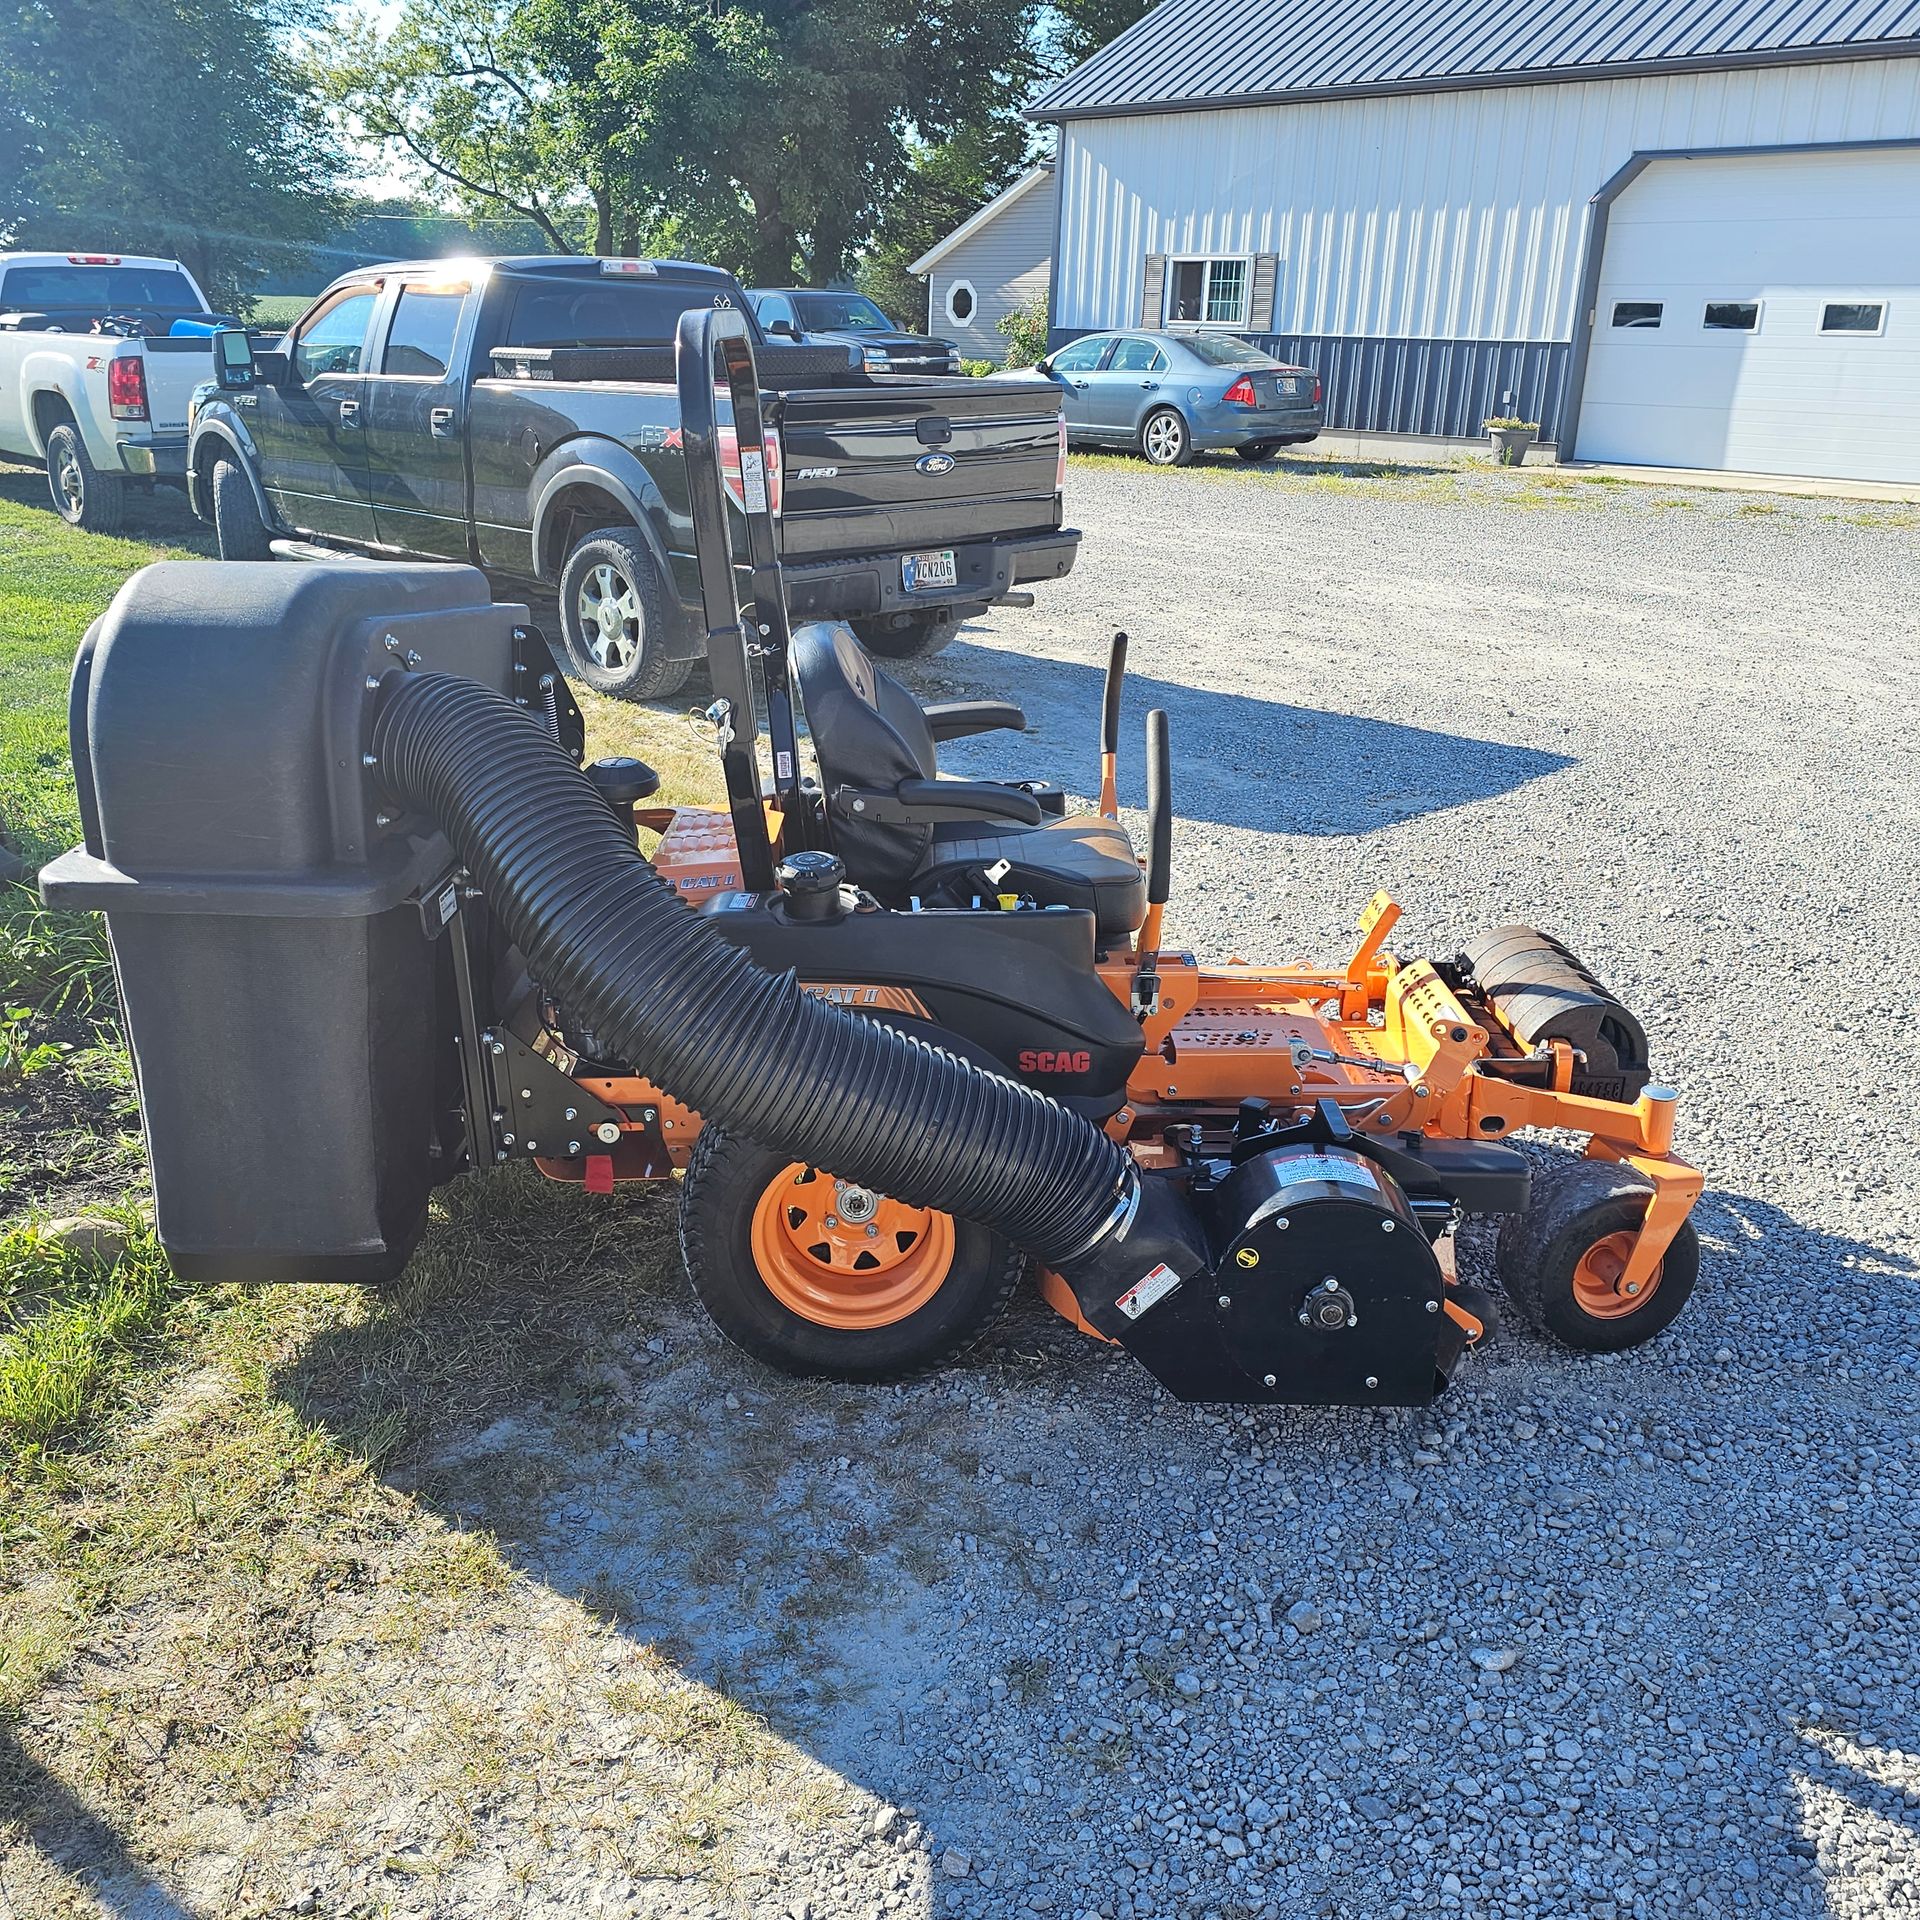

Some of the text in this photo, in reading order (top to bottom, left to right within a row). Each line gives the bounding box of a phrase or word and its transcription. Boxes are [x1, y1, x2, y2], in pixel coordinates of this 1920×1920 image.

[925, 456, 948, 472] Ford
[681, 875, 722, 889] CAT
[724, 874, 735, 886] II
[805, 986, 880, 1004] CAT II
[1019, 1051, 1090, 1073] SCAG
[1134, 1275, 1153, 1293] DANGER
